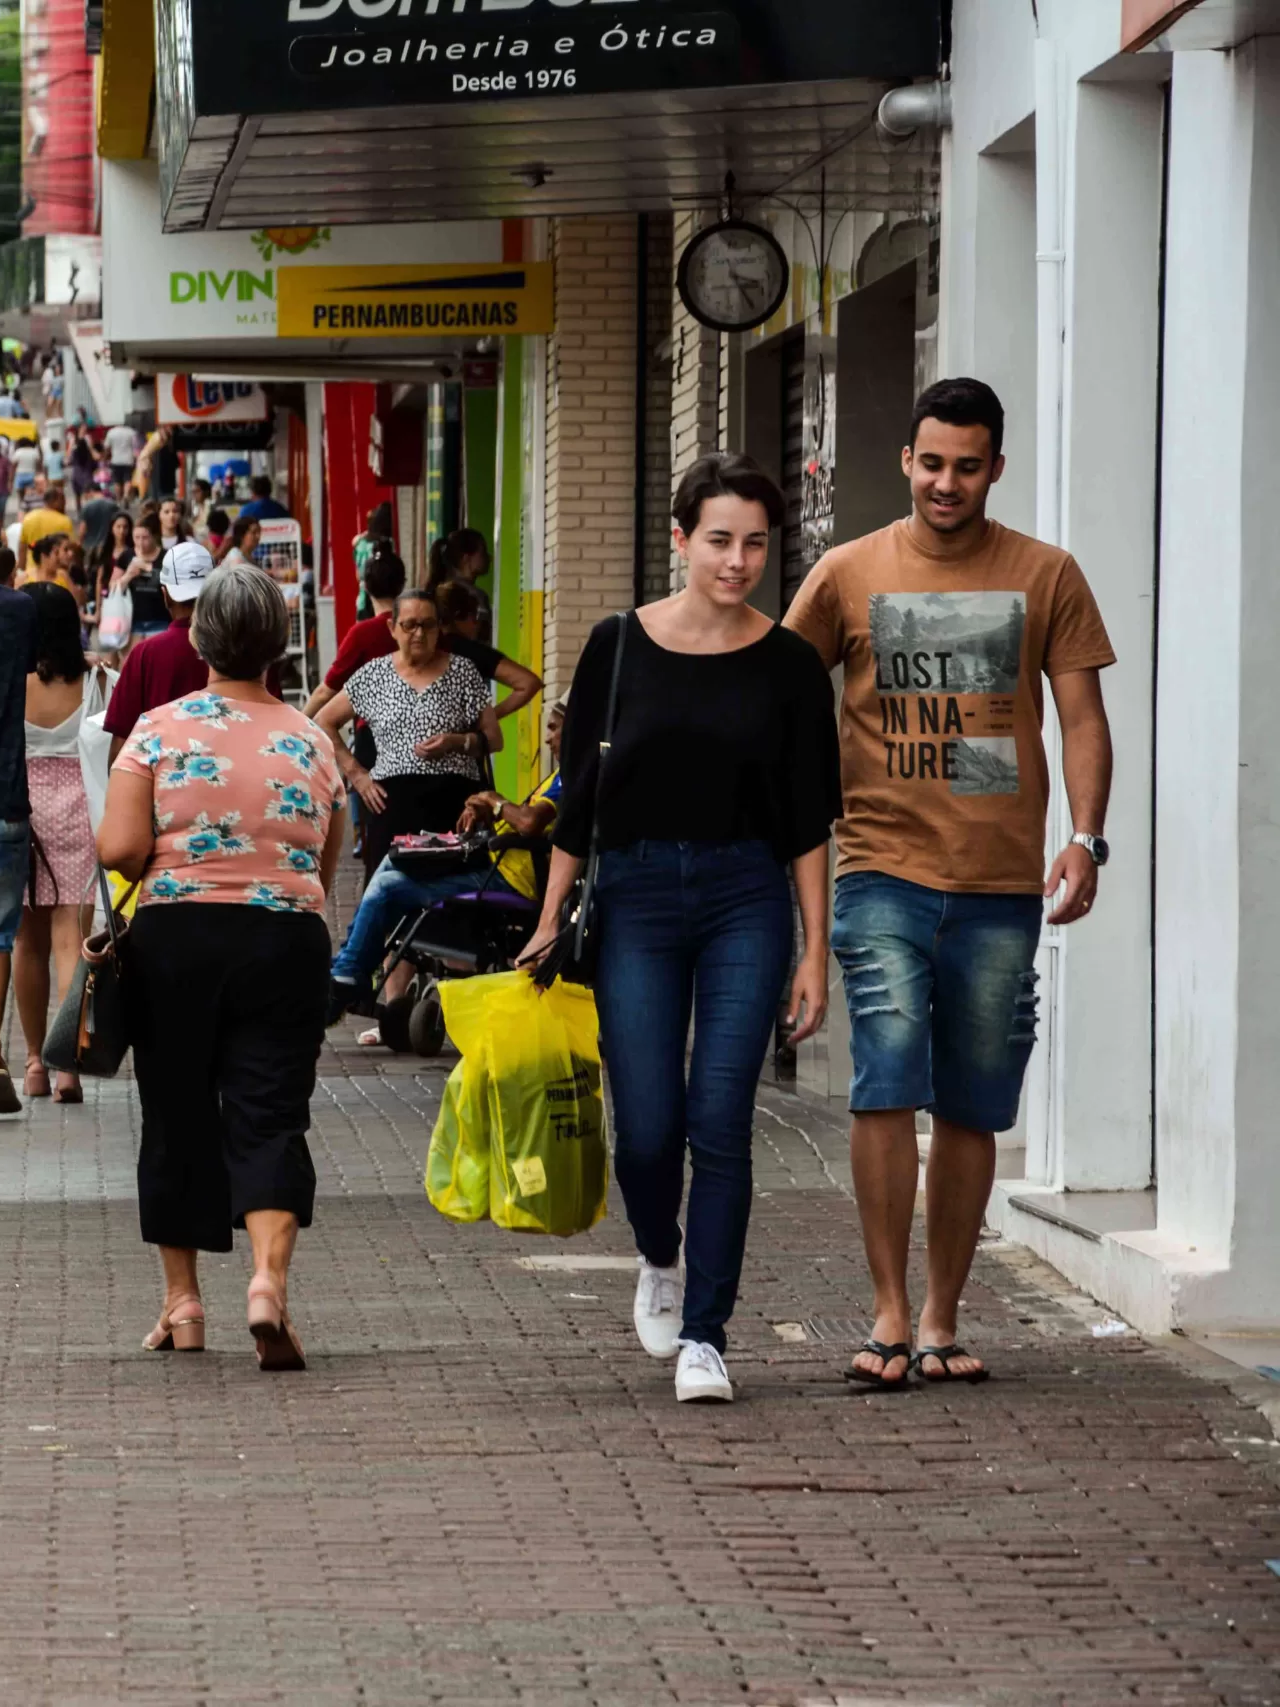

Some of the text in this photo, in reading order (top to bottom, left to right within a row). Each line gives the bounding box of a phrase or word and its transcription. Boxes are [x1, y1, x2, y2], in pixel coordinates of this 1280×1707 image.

[320, 23, 717, 67] Joalheria e Ótica
[452, 69, 577, 92] Desde 1976
[169, 268, 276, 304] DIVIN
[313, 301, 517, 329] PERNAMBUCANAS
[876, 652, 952, 690] LOST
[880, 697, 976, 735] IN NA-
[884, 742, 960, 780] TURE
